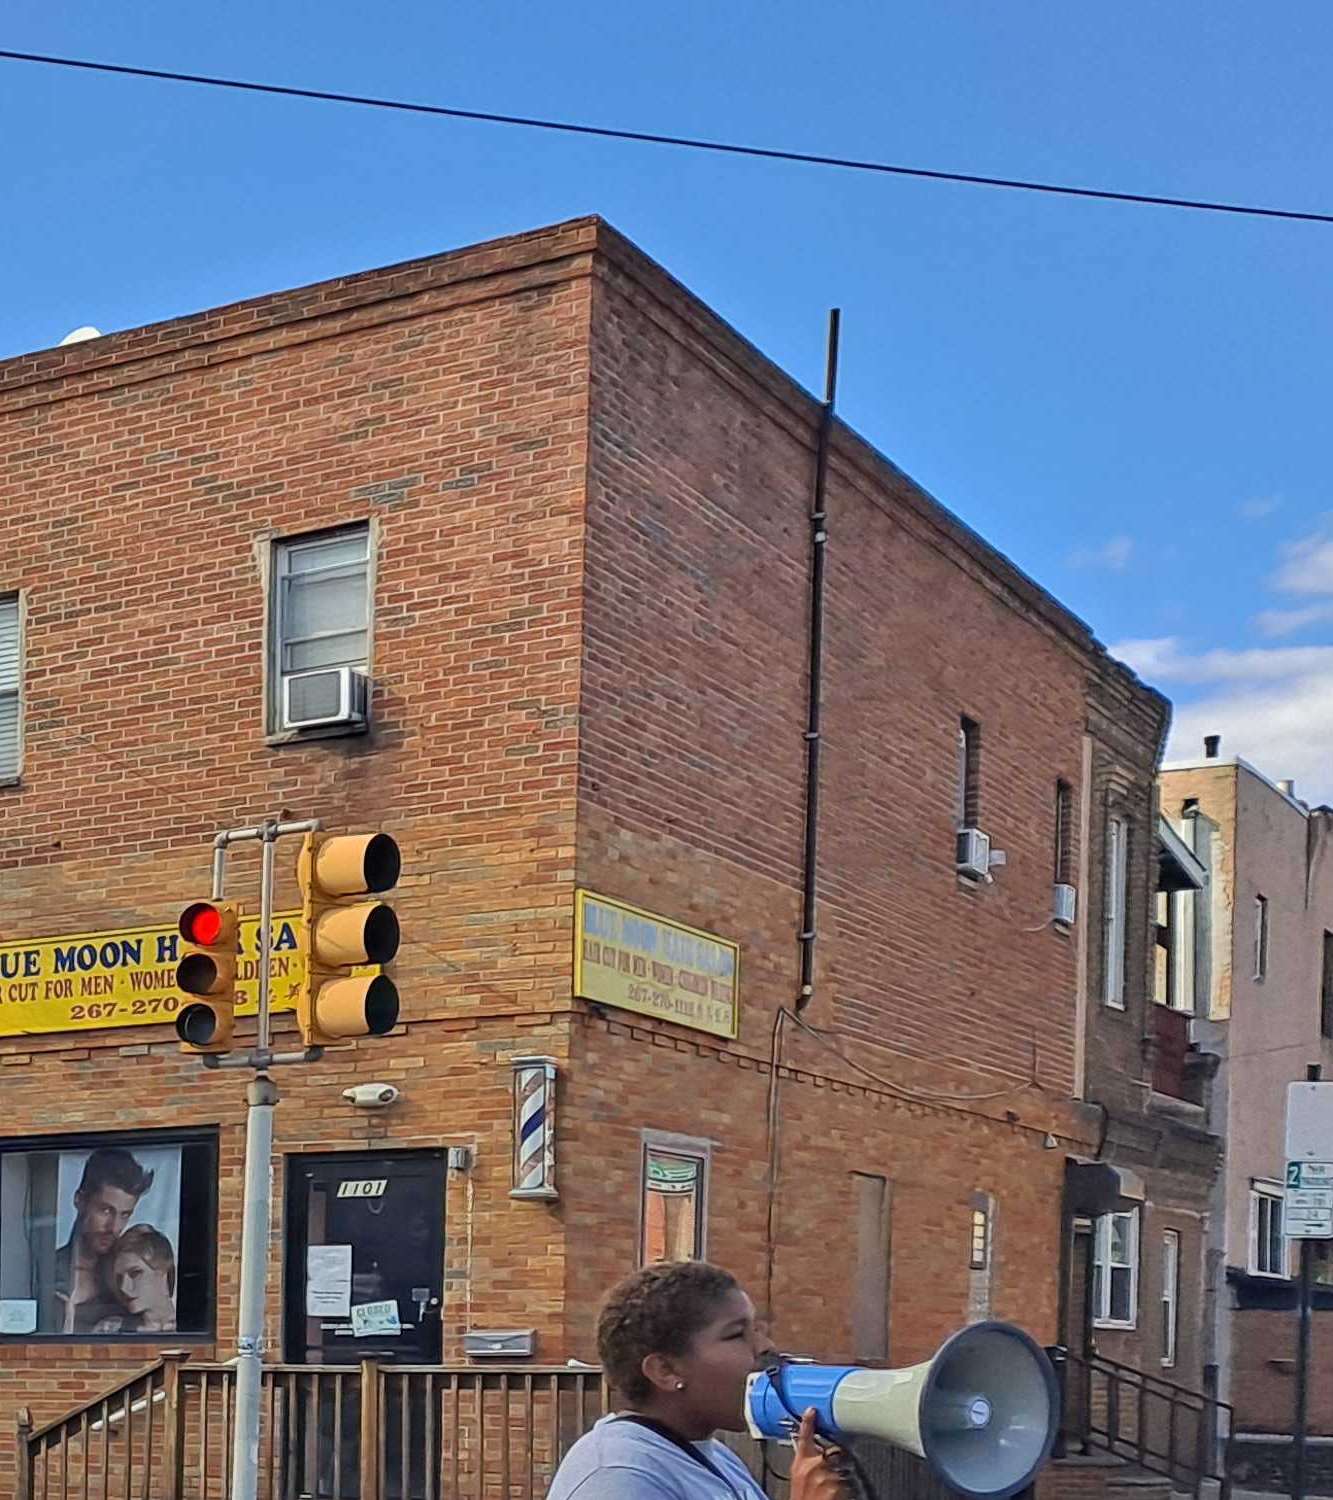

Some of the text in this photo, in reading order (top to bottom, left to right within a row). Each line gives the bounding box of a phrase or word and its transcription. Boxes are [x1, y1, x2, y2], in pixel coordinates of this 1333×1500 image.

[53, 939, 143, 973] MOON
[8, 982, 39, 1002] CUT
[45, 979, 73, 1000] FOR
[81, 975, 114, 996] MEN
[129, 968, 177, 992] WOME
[342, 1181, 384, 1196] 1101
